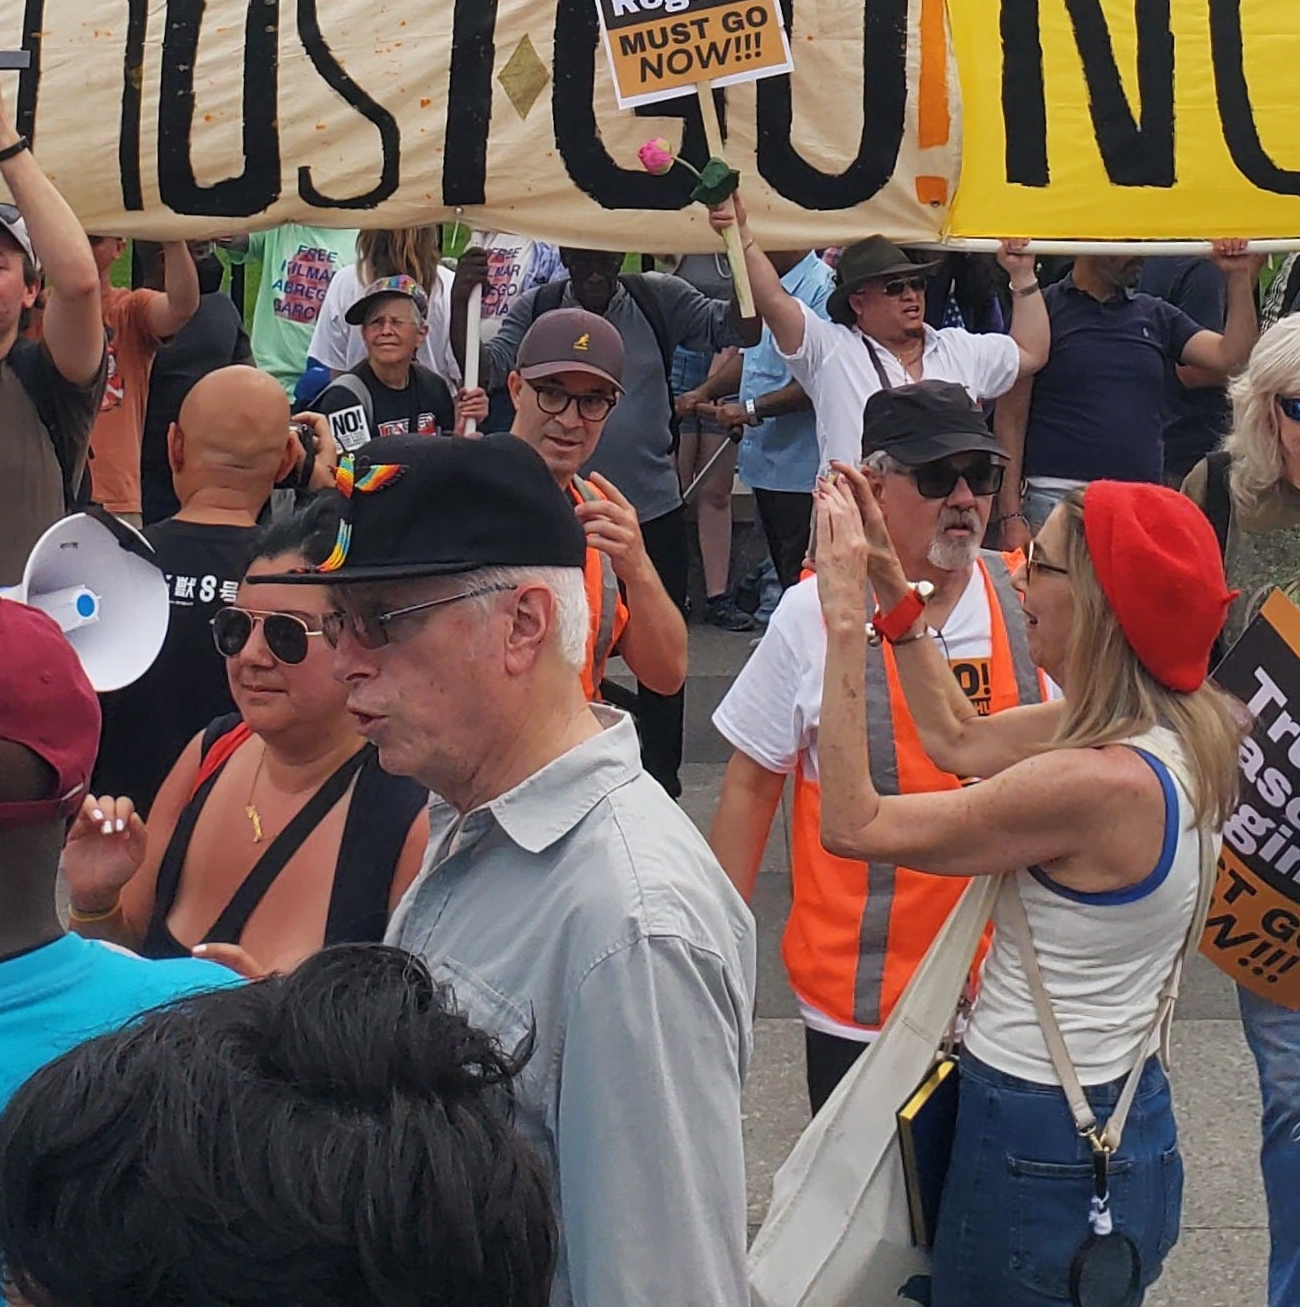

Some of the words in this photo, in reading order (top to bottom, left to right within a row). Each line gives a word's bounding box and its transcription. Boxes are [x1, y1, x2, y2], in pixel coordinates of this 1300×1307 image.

[619, 17, 710, 56] MUST
[721, 5, 768, 33] GO
[640, 31, 762, 83] NOW!!!
[296, 244, 338, 263] FREE
[281, 259, 336, 282] KILMA
[272, 279, 326, 302] ABREG
[273, 298, 319, 321] GARC
[331, 409, 364, 437] NO!
[953, 662, 991, 696] O!
[1205, 914, 1300, 982] W!!!
